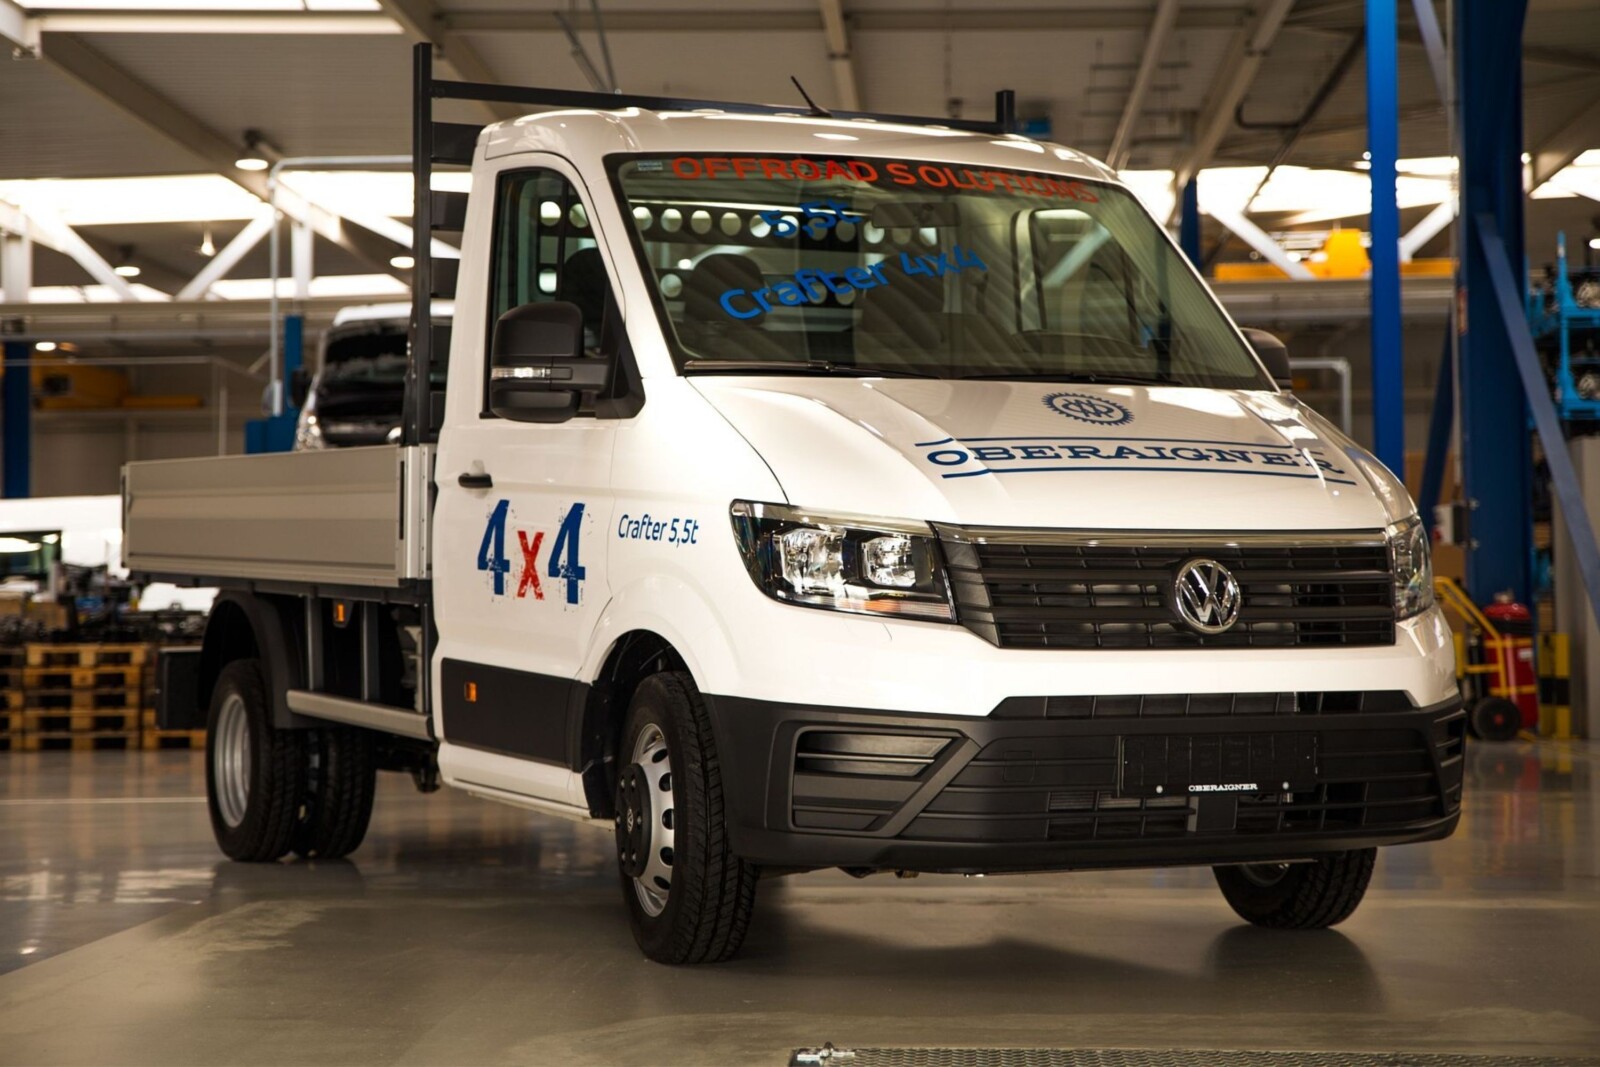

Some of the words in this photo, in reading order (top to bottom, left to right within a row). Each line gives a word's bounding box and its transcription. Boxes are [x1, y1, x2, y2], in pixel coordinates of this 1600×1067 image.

[671, 157, 879, 184] OFFROAD
[887, 163, 1099, 204] SOLUTIONS
[759, 200, 863, 238] 5,5t
[718, 262, 890, 320] Crafter
[900, 244, 988, 278] 4x4
[926, 445, 1345, 474] OBERAIGNER
[618, 514, 668, 541] Crafter
[668, 518, 699, 548] 5,5t
[477, 499, 586, 605] 4x4
[1188, 783, 1258, 792] OBERAIGNER
